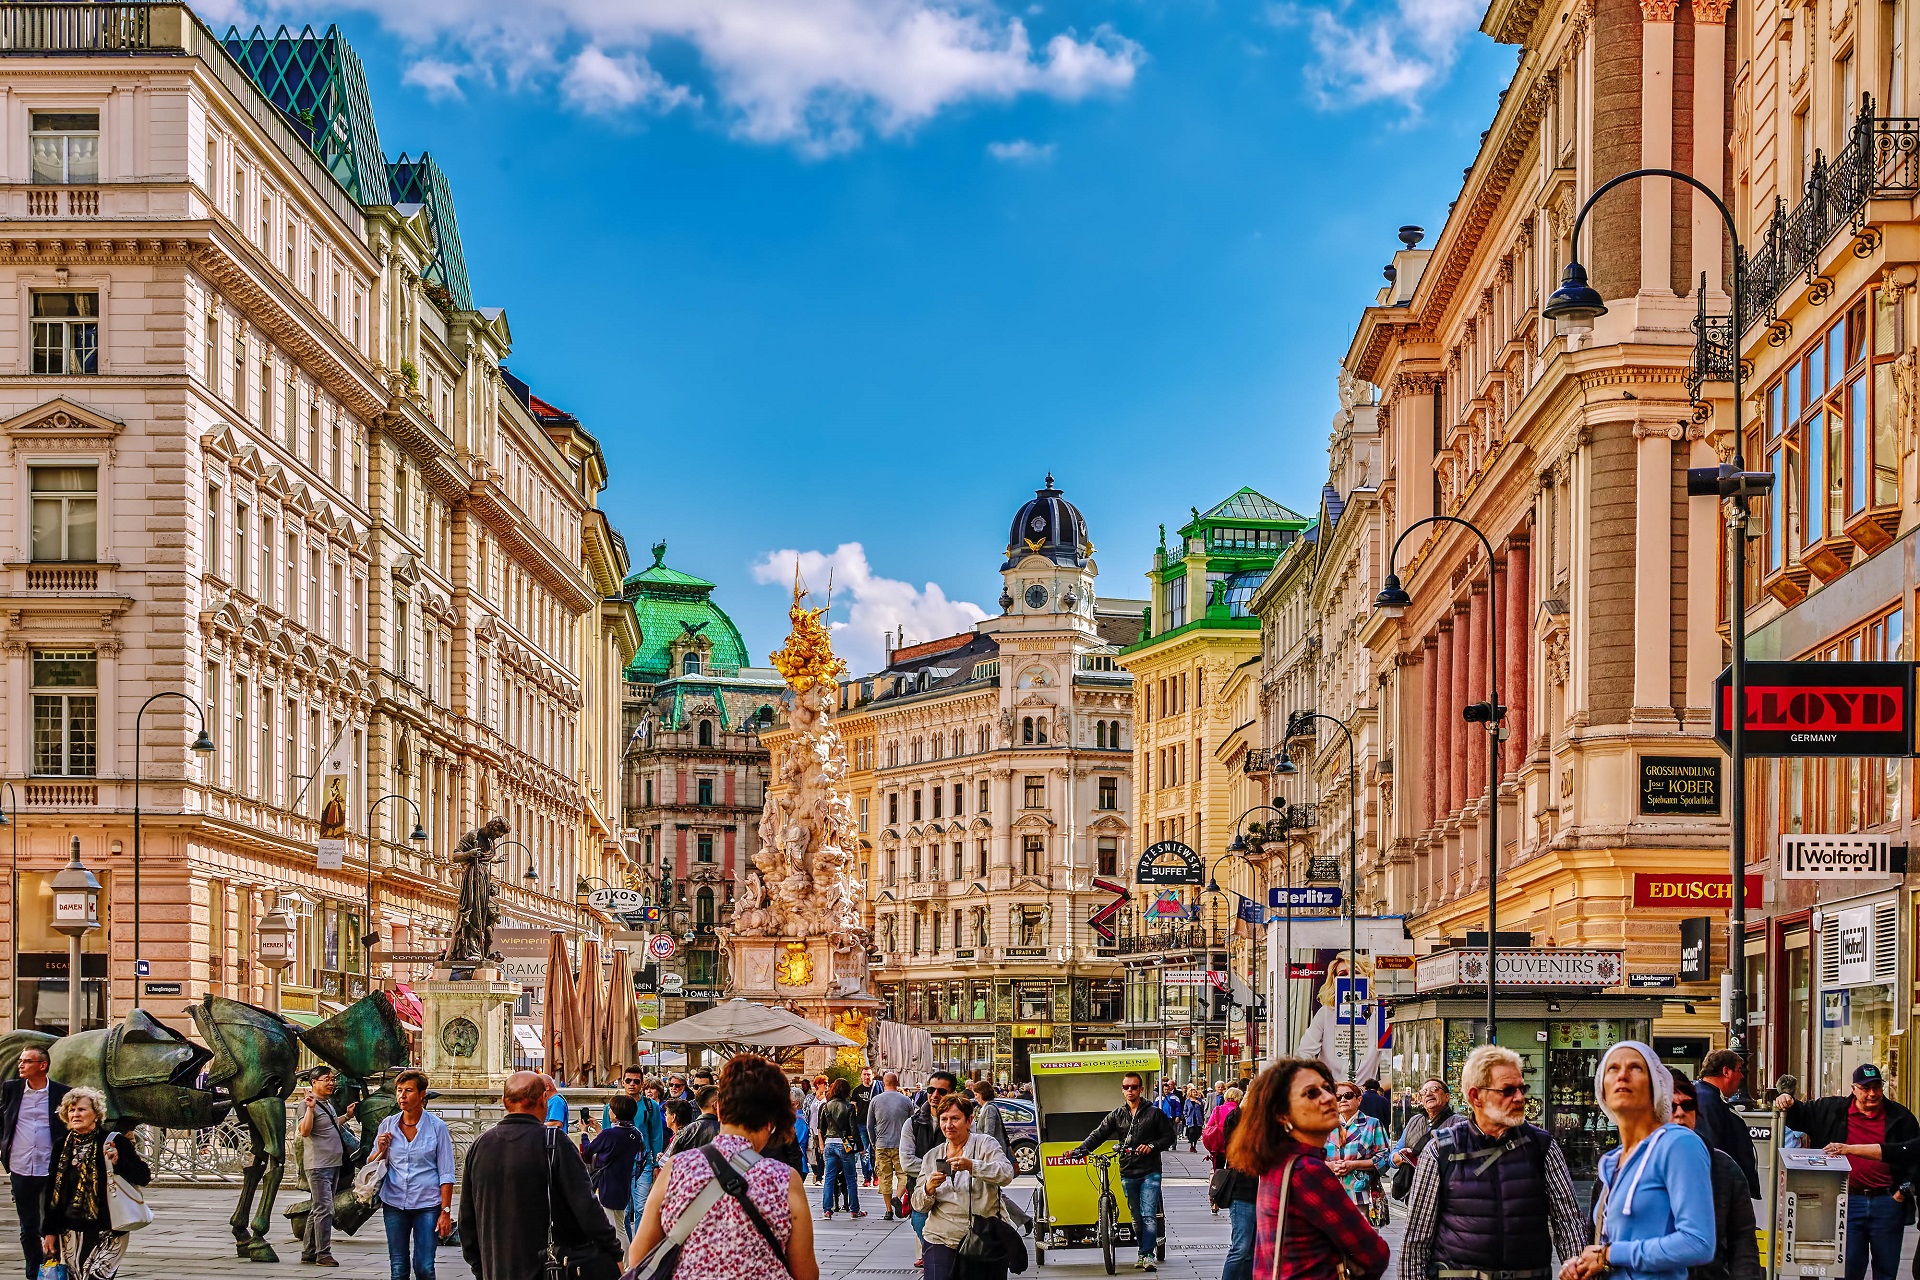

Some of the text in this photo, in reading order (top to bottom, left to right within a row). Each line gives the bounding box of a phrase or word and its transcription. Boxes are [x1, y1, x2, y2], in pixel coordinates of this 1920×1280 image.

[1791, 734, 1837, 742] GERMANY
[1646, 766, 1715, 776] GROSSHANDLUNG
[1669, 780, 1714, 793] KOBER
[1804, 850, 1869, 864] Wolford
[595, 891, 638, 902] ZIKOS
[1277, 890, 1333, 904] Berlitz
[1682, 948, 1698, 960] MONT
[1682, 960, 1698, 972] BLANC
[1082, 1059, 1149, 1067] SIGHTSEEING
[1750, 1127, 1770, 1138] ÖVP
[1047, 1156, 1085, 1165] VIENNA
[1785, 1197, 1794, 1263] GRATIS
[1802, 1266, 1826, 1275] 0818
